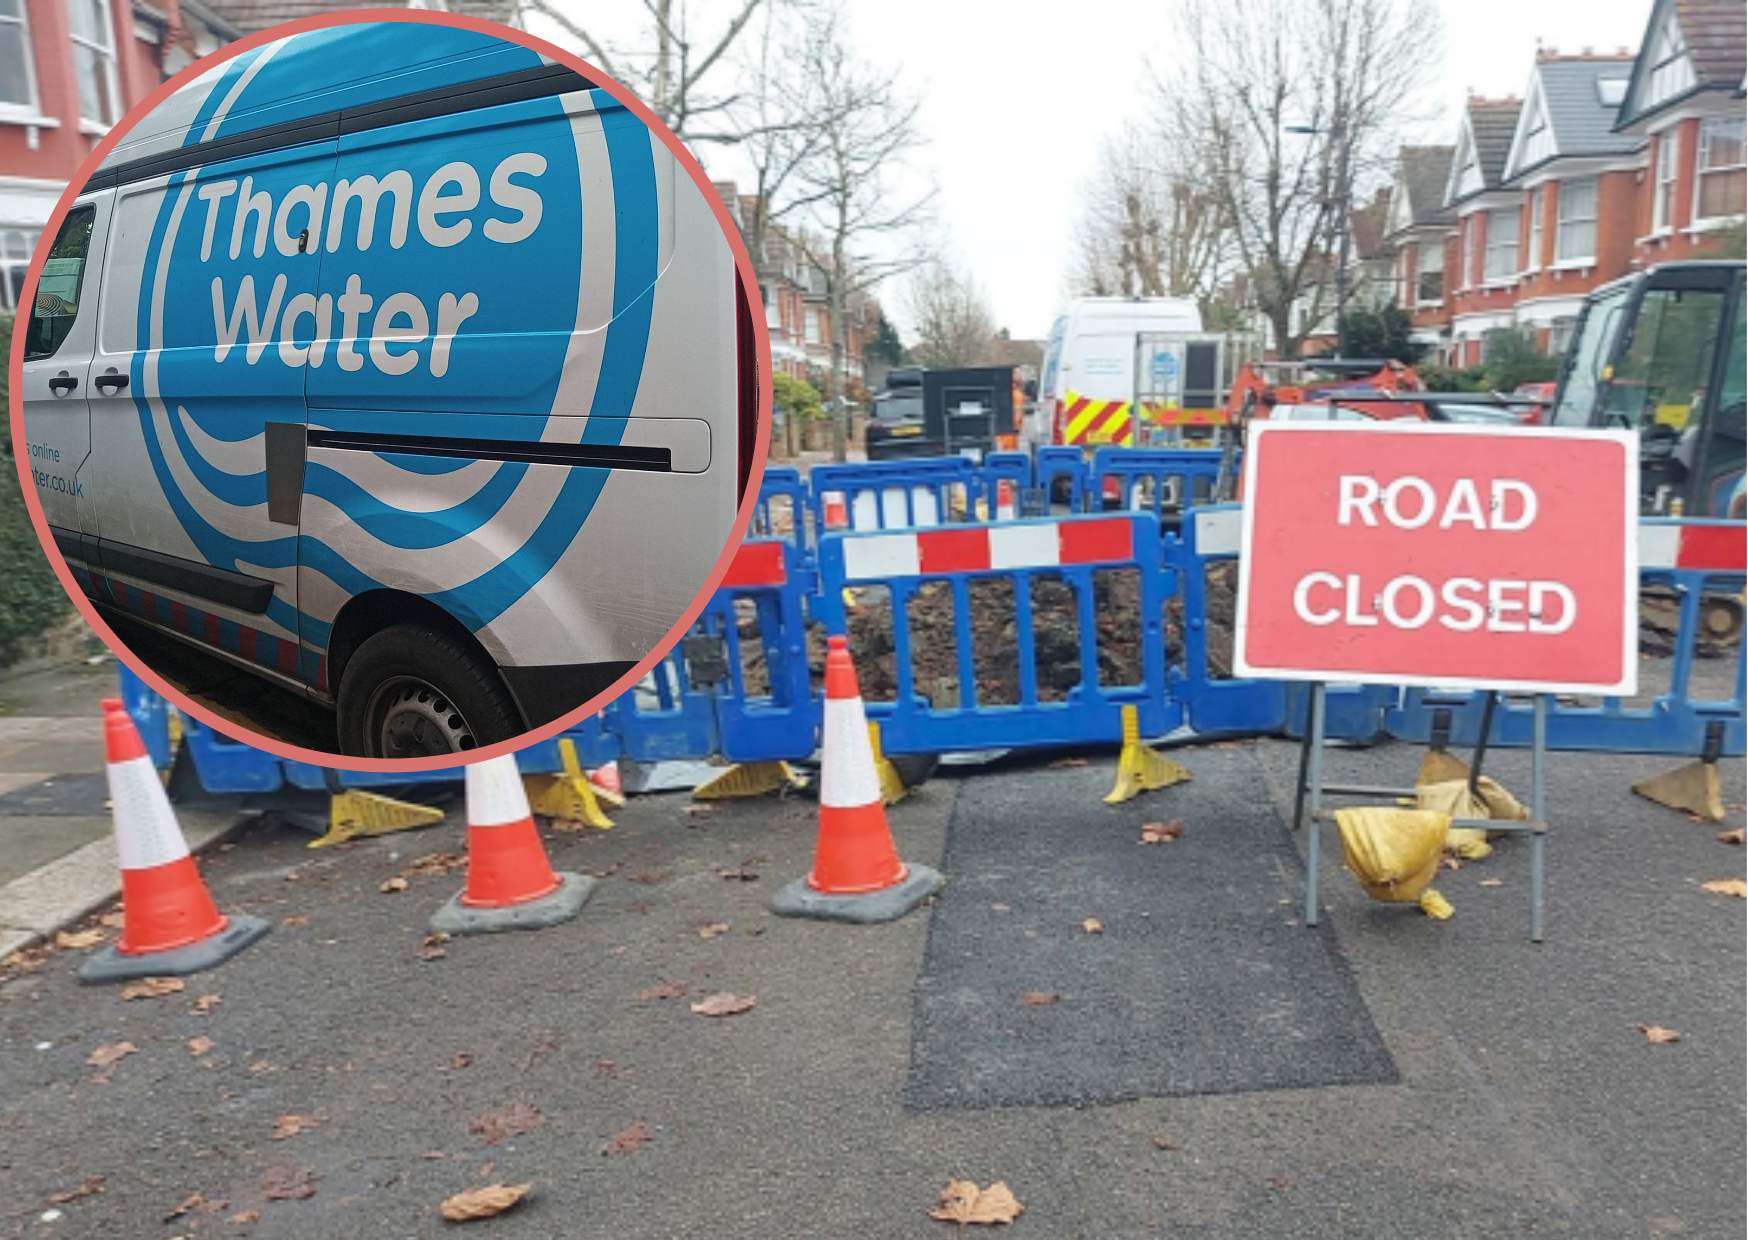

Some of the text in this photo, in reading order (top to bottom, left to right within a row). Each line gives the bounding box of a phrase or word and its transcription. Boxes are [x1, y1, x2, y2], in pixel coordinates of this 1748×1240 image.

[198, 152, 548, 263] Thames
[211, 273, 480, 378] Water
[32, 442, 60, 463] online
[1337, 475, 1538, 531] ROAD
[1293, 572, 1577, 635] CLOSED
